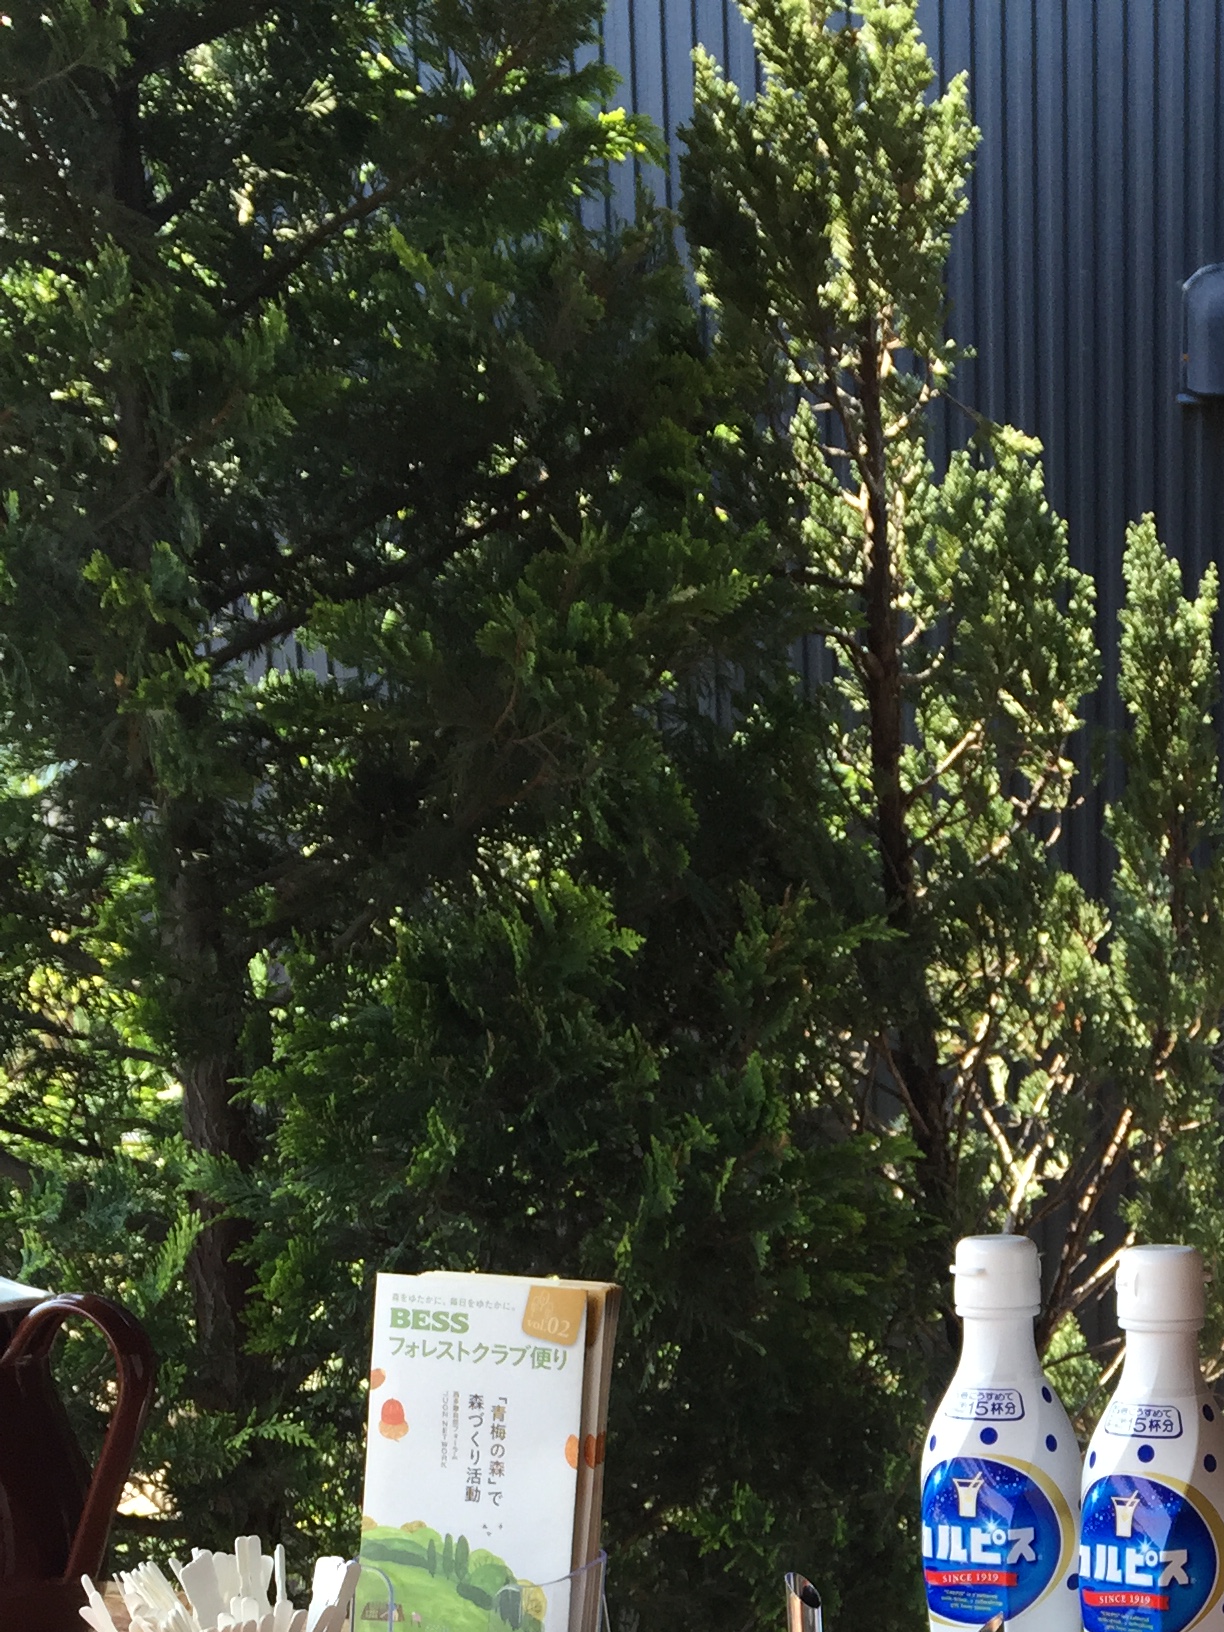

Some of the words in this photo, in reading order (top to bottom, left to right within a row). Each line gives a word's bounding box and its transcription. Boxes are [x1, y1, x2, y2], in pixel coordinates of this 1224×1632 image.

[389, 1307, 470, 1334] BESS
[389, 1336, 568, 1371] フォレストクラブ便り
[464, 1393, 485, 1503] 森づくり活動
[487, 1396, 508, 1507] 「青梅の森」で
[942, 1574, 973, 1583] SINCE
[976, 1573, 999, 1582] 1919
[1099, 1593, 1127, 1604] SINCE
[1130, 1594, 1151, 1604] 1919
